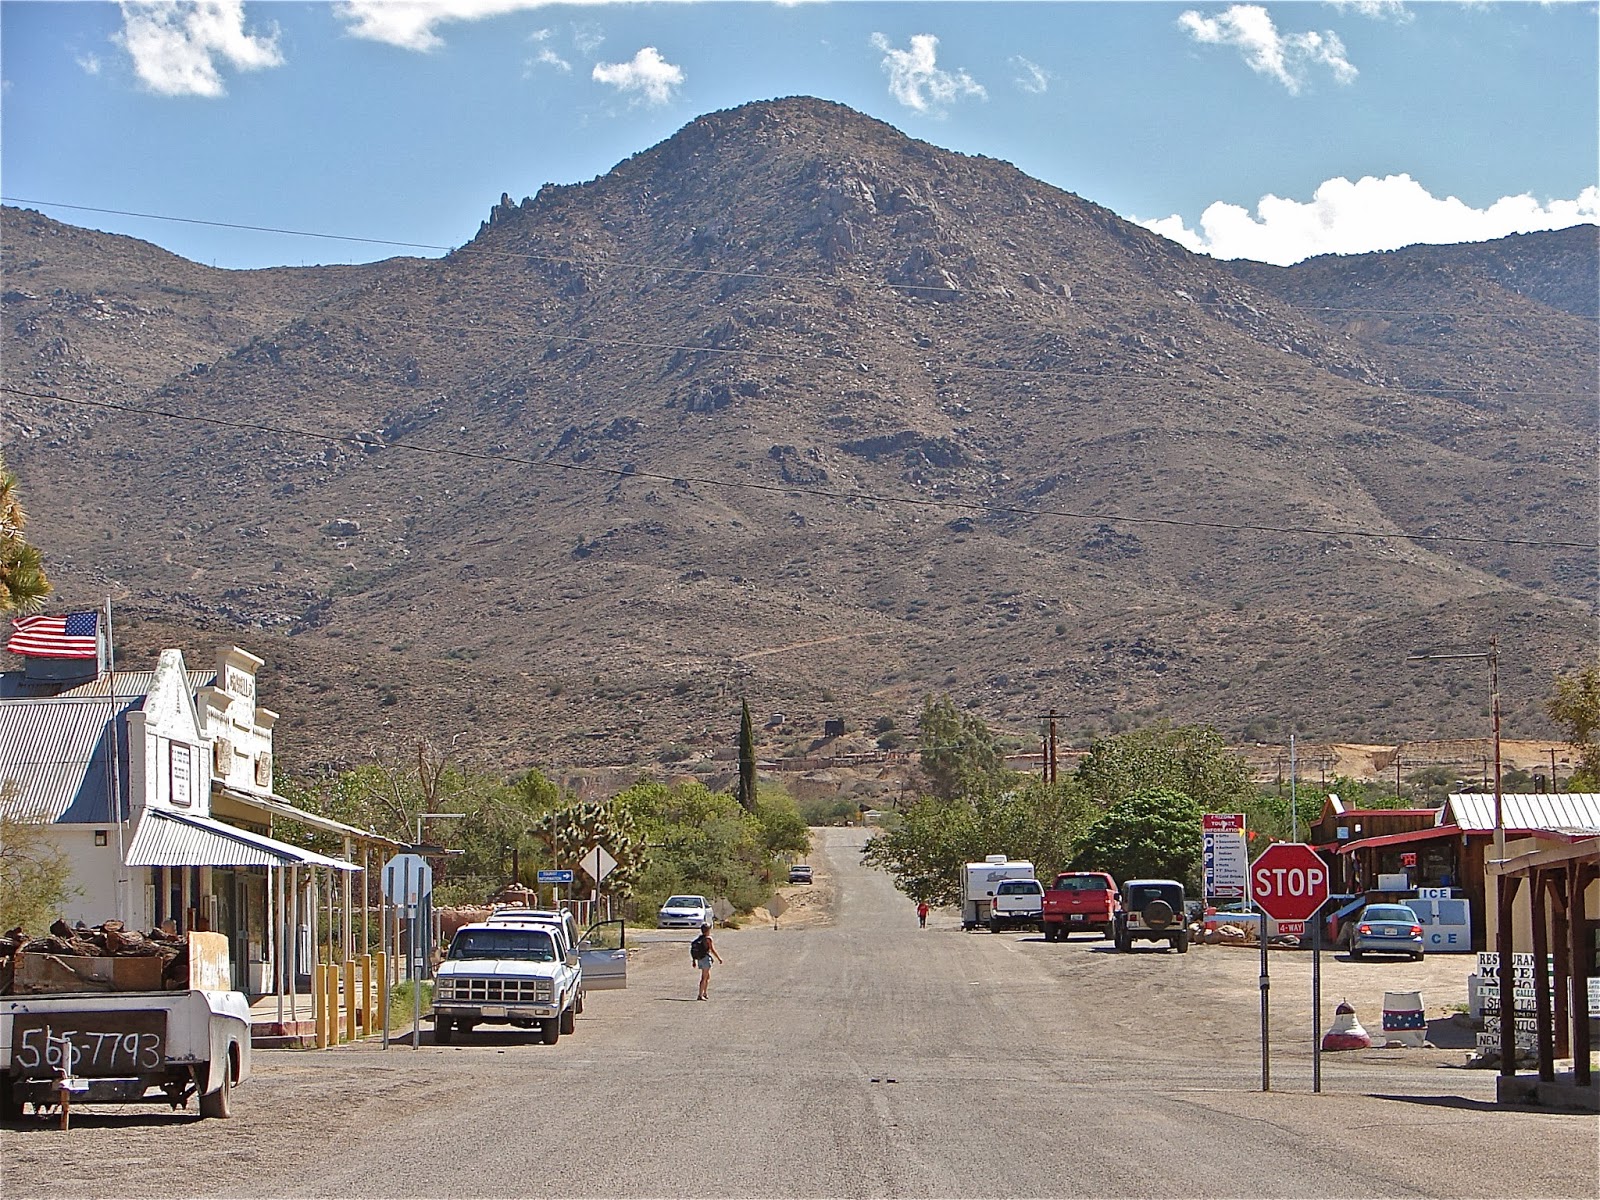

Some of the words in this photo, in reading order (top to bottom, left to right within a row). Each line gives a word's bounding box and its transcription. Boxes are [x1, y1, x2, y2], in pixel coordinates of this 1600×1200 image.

[1204, 837, 1214, 893] OPEN
[1256, 868, 1323, 897] STOP
[1423, 889, 1447, 899] ICE
[1280, 923, 1303, 932] 4-WAY
[1431, 933, 1457, 944] CE
[1480, 1036, 1499, 1046] NEW
[16, 1028, 160, 1068] 565-7793
